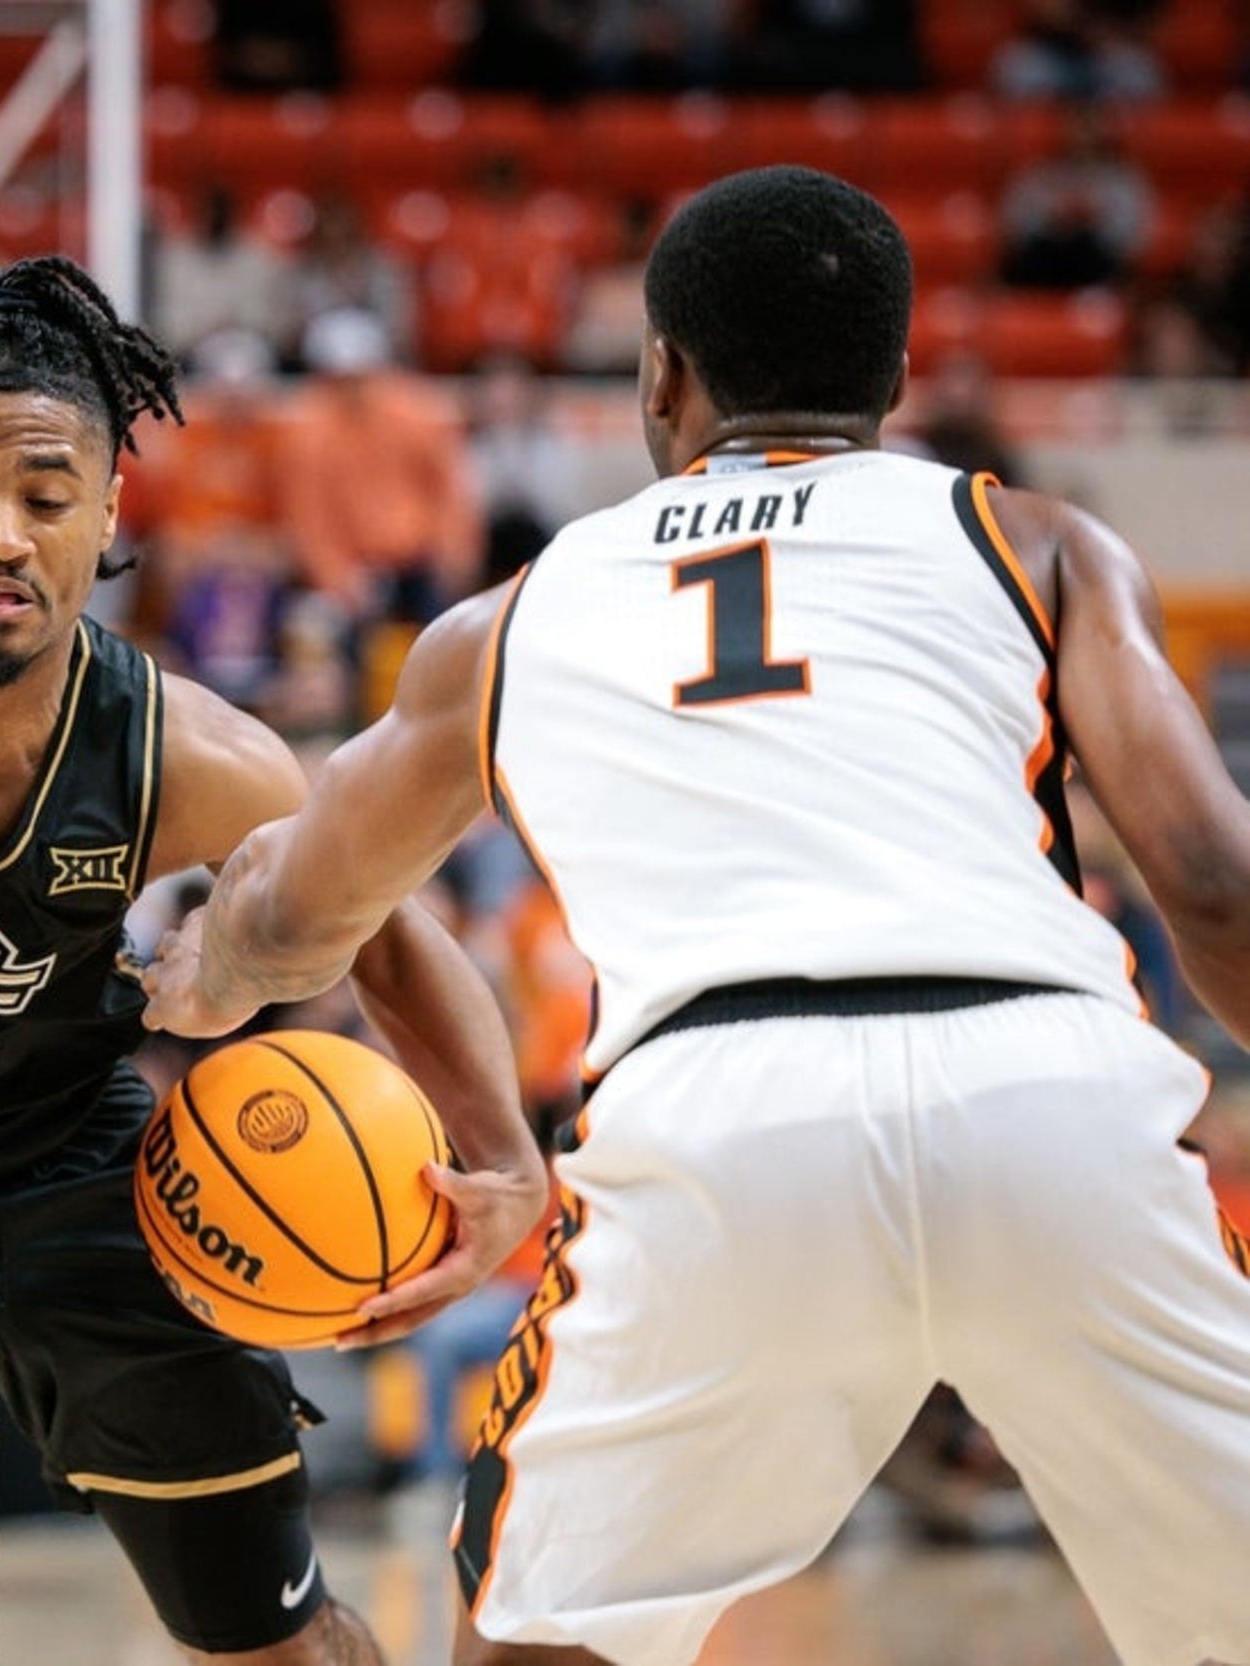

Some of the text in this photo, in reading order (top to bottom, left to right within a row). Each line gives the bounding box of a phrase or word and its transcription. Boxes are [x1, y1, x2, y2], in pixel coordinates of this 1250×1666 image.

[654, 480, 817, 544] CLARY
[669, 537, 812, 710] 1
[49, 844, 129, 895] XII
[144, 1107, 265, 1288] Wilson
